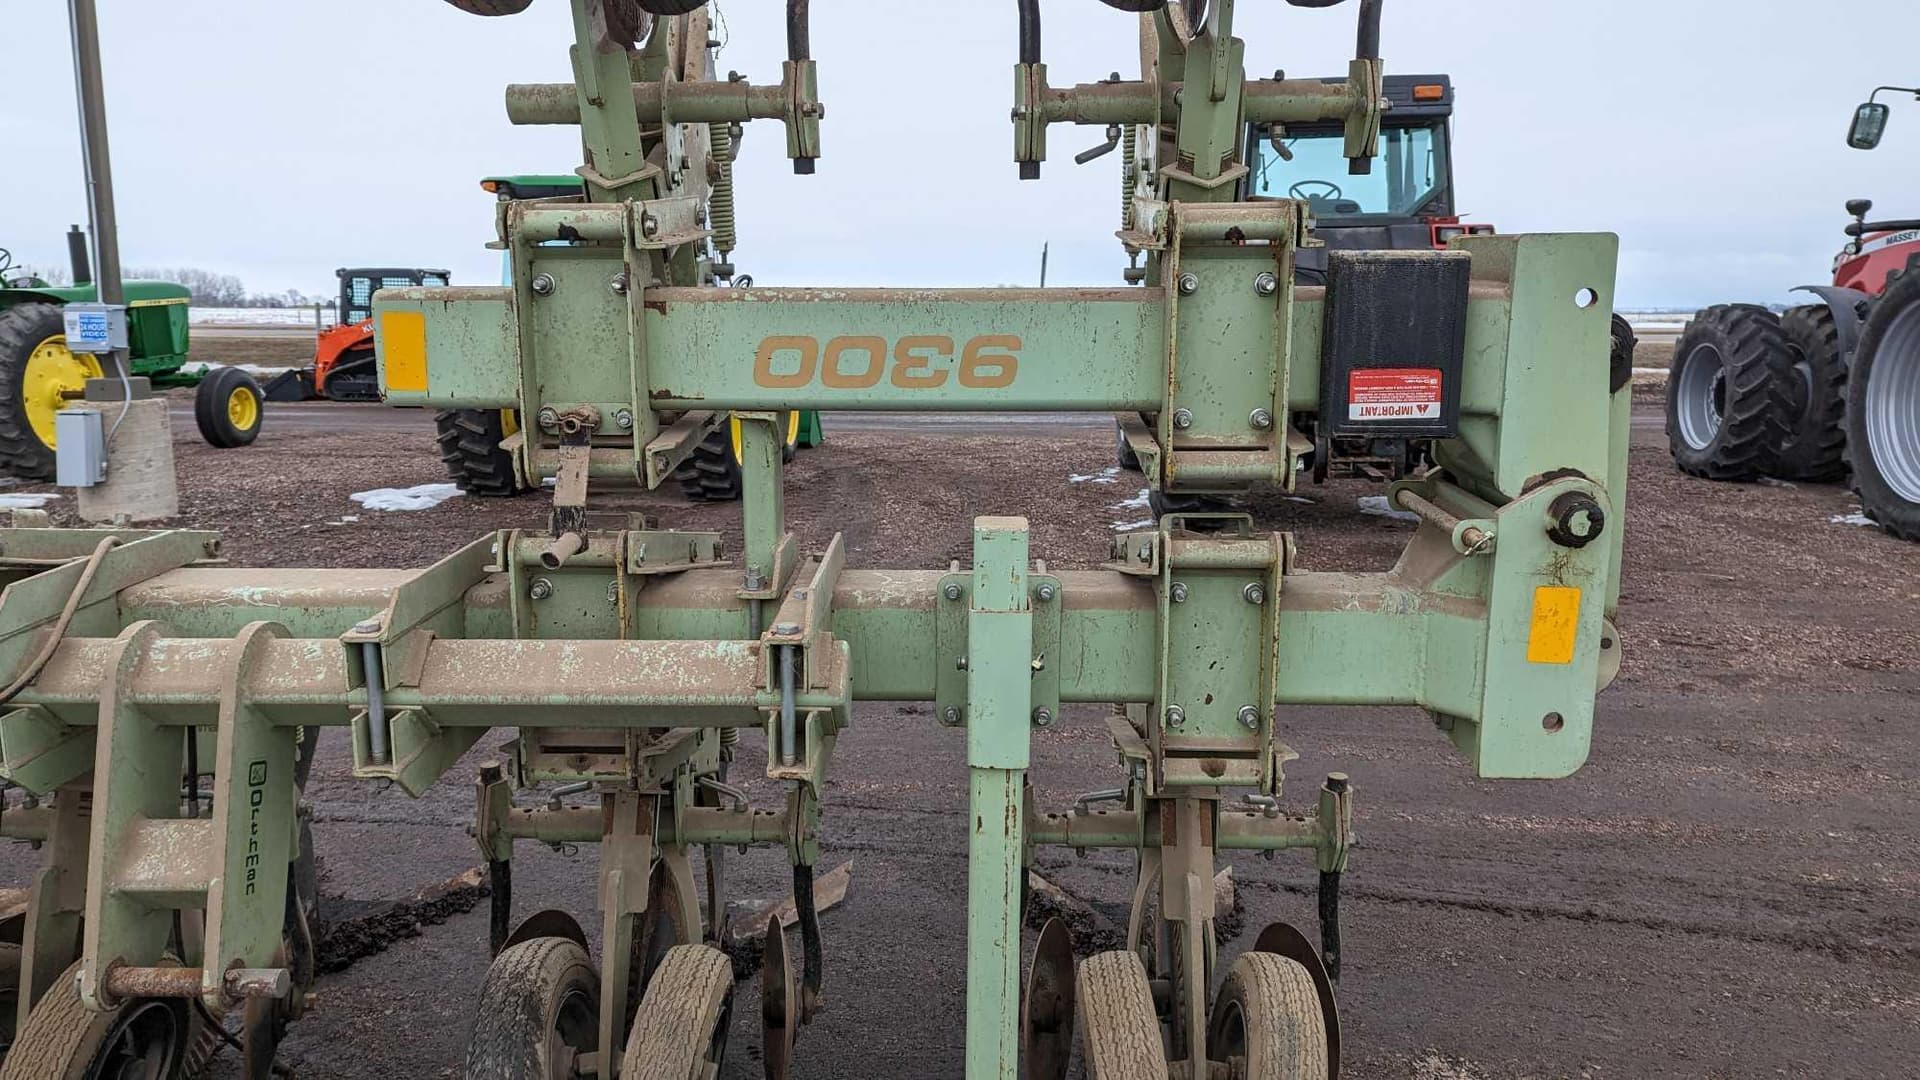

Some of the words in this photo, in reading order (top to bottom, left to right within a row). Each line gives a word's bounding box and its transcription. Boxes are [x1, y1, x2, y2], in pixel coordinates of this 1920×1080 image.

[1886, 231, 1917, 246] MASSEY
[753, 335, 1022, 389] 9300
[1359, 406, 1413, 416] IMPORTANT
[246, 789, 262, 896] Orthman
